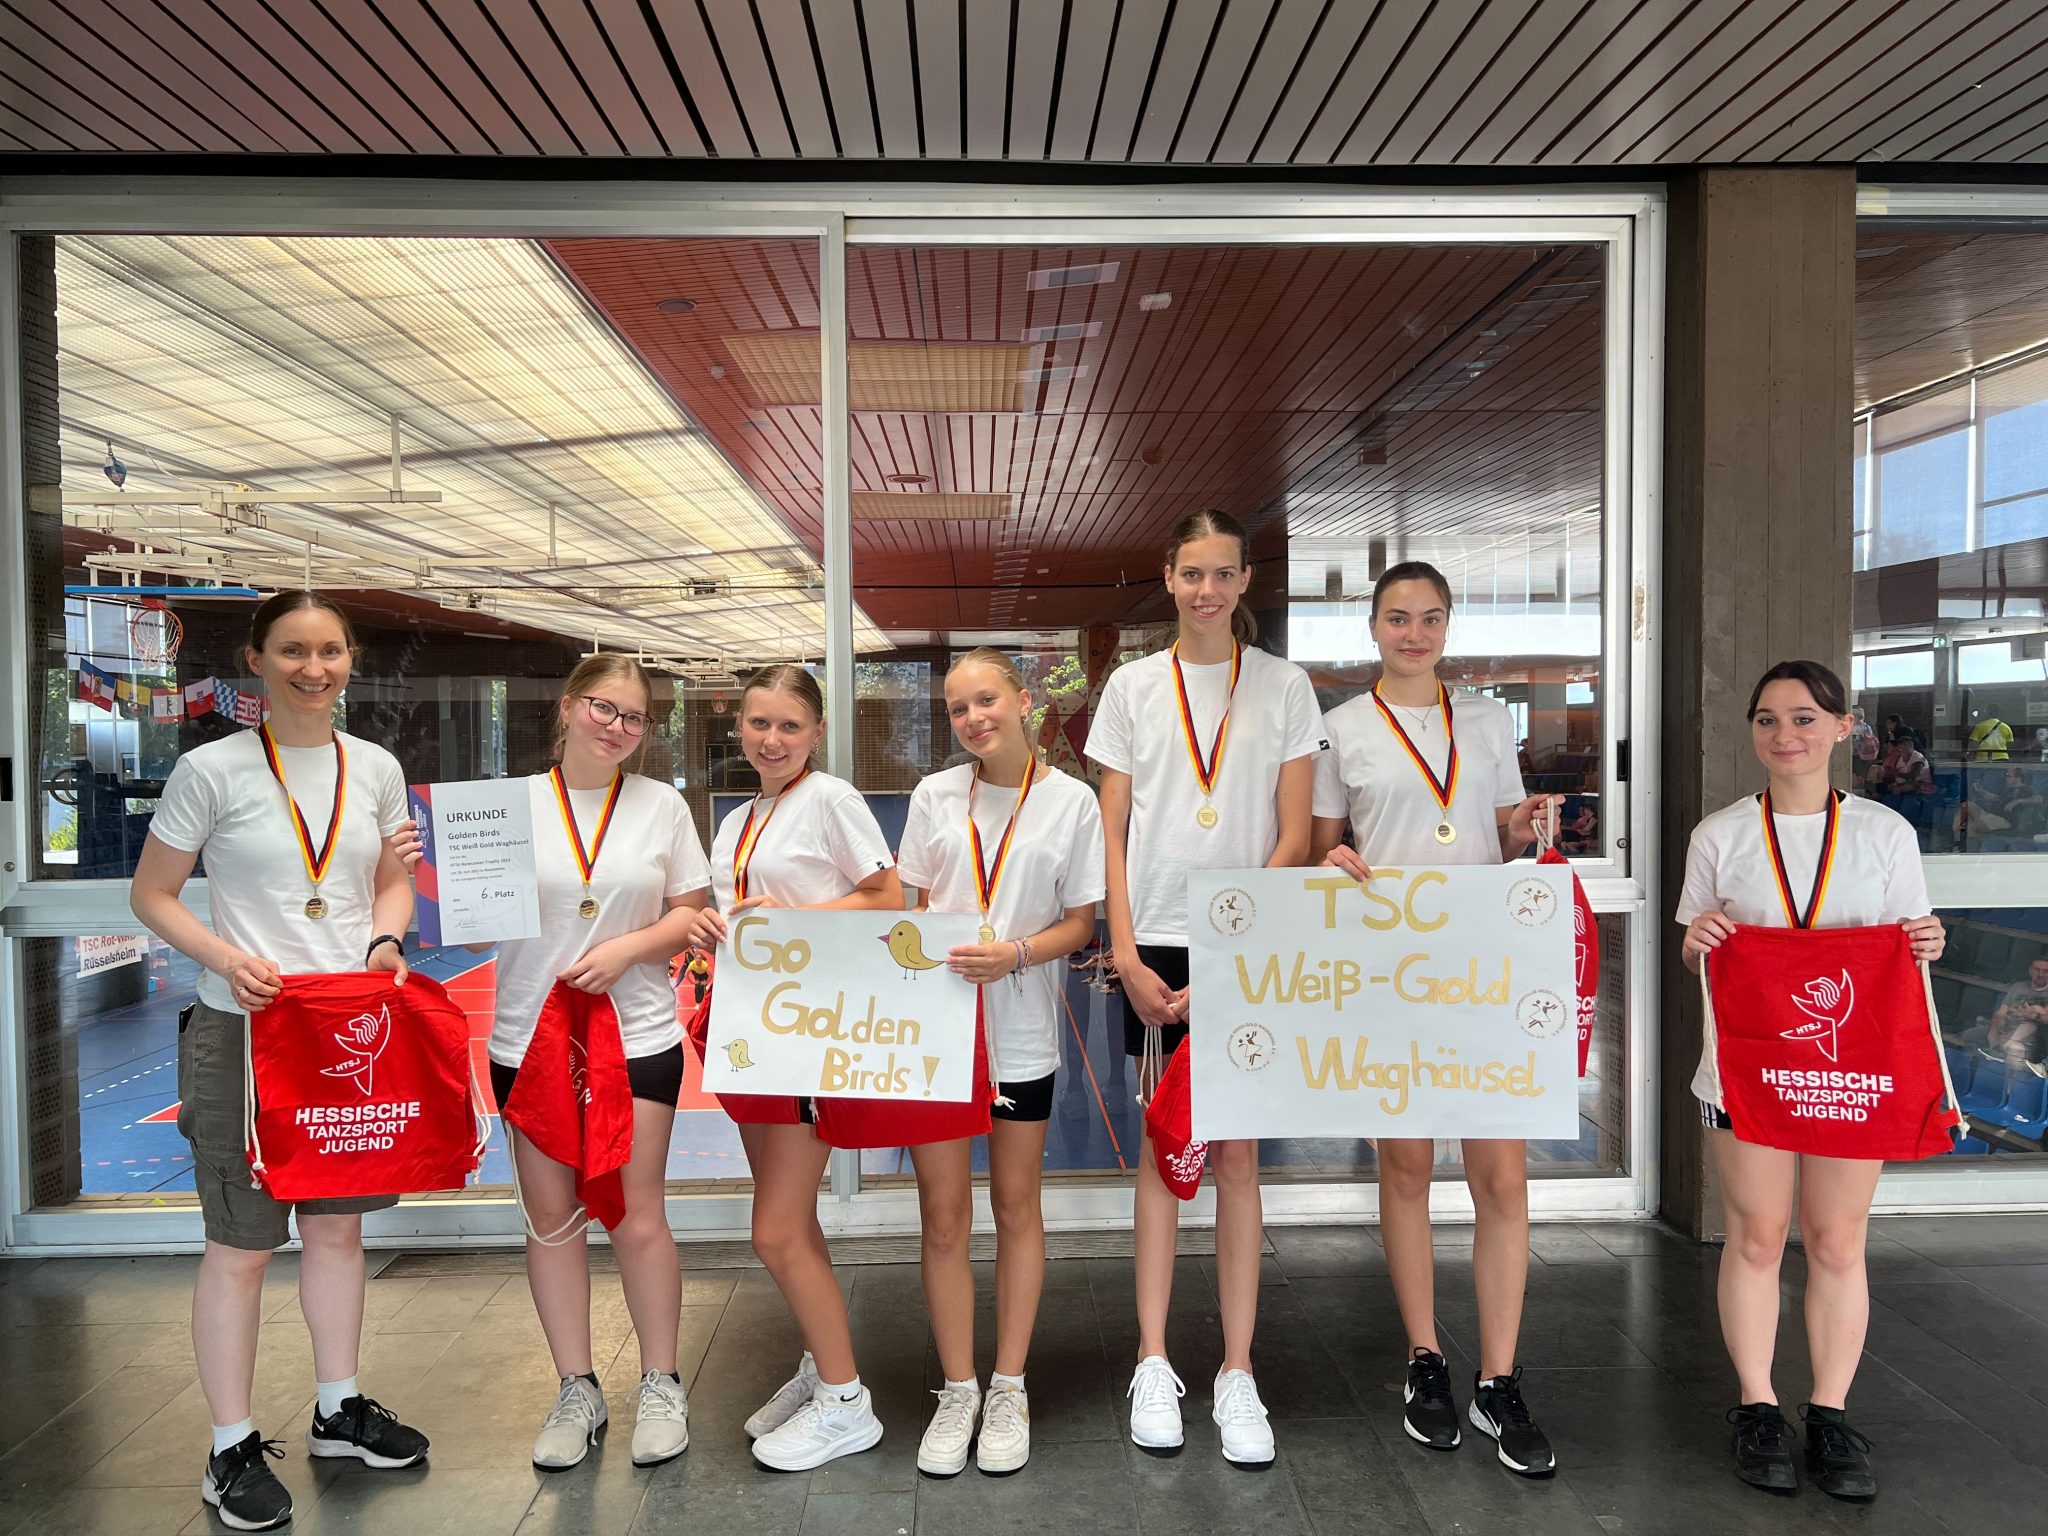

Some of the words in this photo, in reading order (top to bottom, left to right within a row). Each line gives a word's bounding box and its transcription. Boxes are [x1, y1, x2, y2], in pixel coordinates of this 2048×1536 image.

[446, 808, 508, 823] URKUNDE
[448, 831, 478, 840] Golden
[480, 829, 500, 838] Birds
[449, 843, 461, 851] TSC
[461, 841, 478, 850] Weiß
[480, 840, 494, 849] Gold
[496, 838, 529, 849] Waghäusel
[495, 890, 515, 898] Platz
[1304, 868, 1449, 933] TSC
[83, 937, 99, 953] TSC
[734, 916, 811, 974] Go
[83, 947, 137, 971] Rüsselsheim
[761, 981, 921, 1045] Golden
[1796, 1021, 1822, 1035] HTSJ
[336, 1058, 361, 1072] HTSJ
[1296, 1036, 1545, 1115] Waghäusel
[1761, 1068, 1894, 1093] HESSISCHE
[1775, 1087, 1881, 1107] TANZSPORT
[295, 1101, 420, 1125] HESSISCHE
[1791, 1104, 1868, 1122] JUGEND
[306, 1120, 408, 1139] TANZSPORT
[319, 1136, 394, 1154] JUGEND
